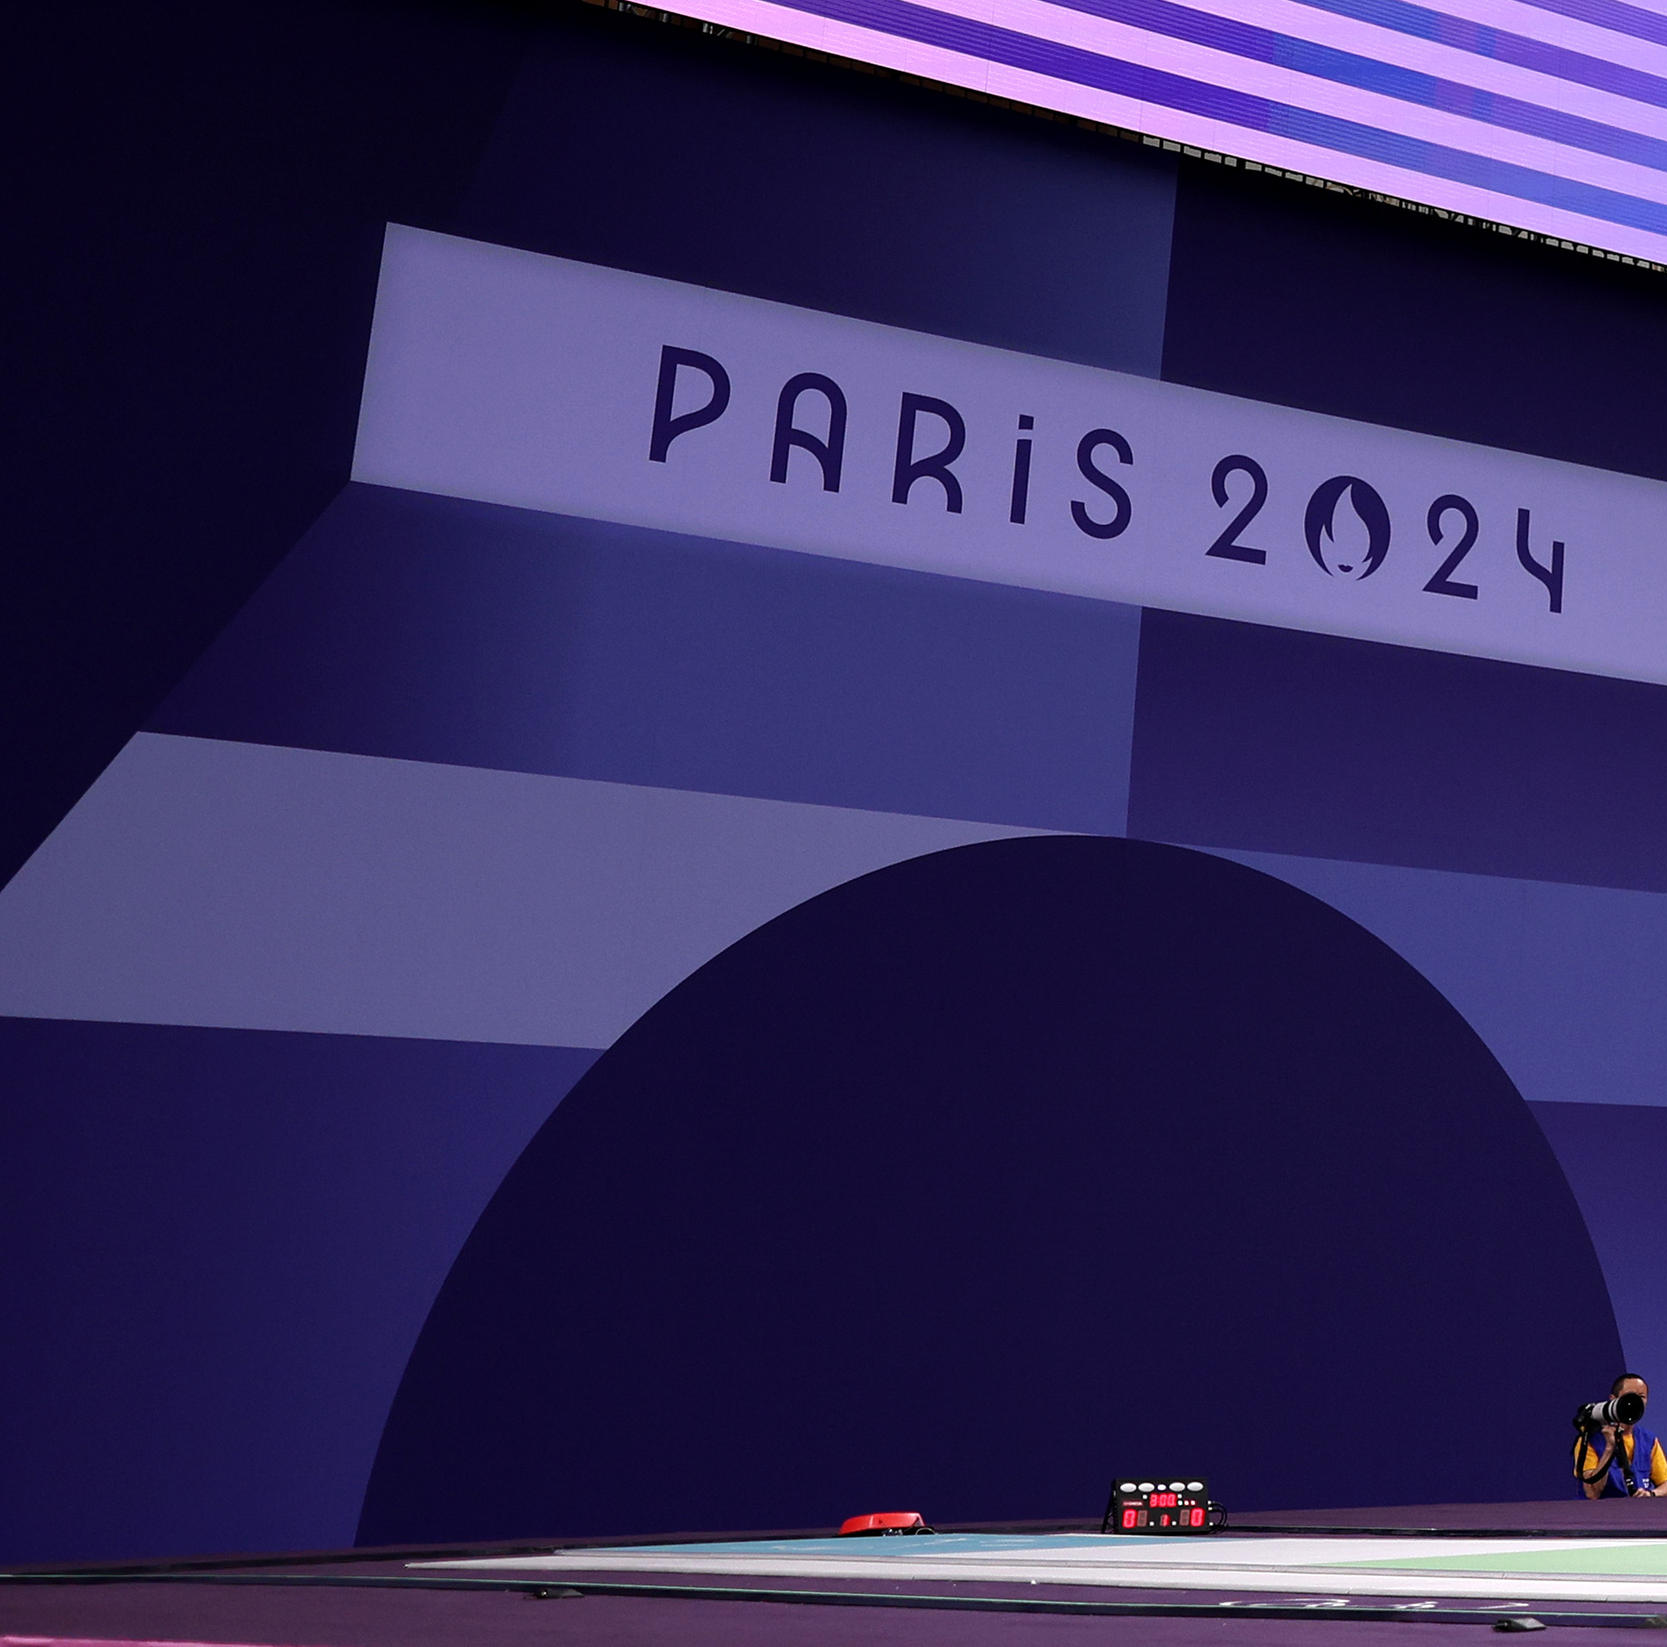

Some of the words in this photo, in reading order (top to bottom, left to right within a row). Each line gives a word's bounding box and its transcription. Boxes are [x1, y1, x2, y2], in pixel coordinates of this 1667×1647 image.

[1206, 452, 1567, 615] 2024
[1122, 1508, 1137, 1528] 0
[1190, 1508, 1205, 1527] 0
